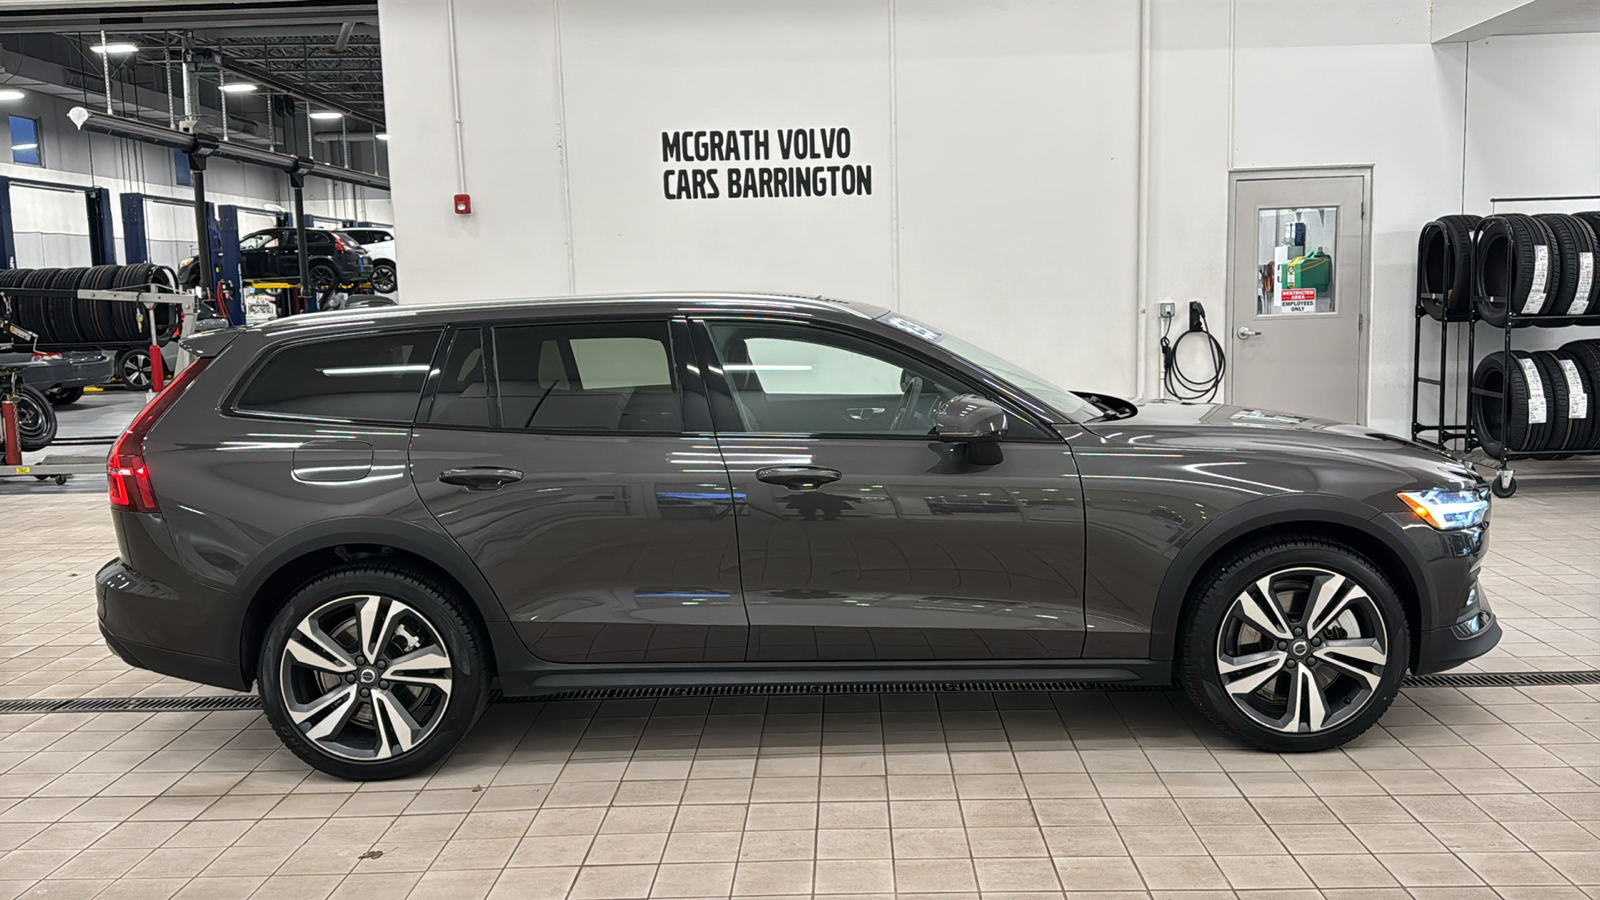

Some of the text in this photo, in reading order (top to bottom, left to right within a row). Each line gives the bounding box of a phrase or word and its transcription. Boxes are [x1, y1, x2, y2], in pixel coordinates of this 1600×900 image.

[662, 127, 851, 162] MCGRATH VOLVO
[664, 164, 872, 199] CARS BARRINGTON
